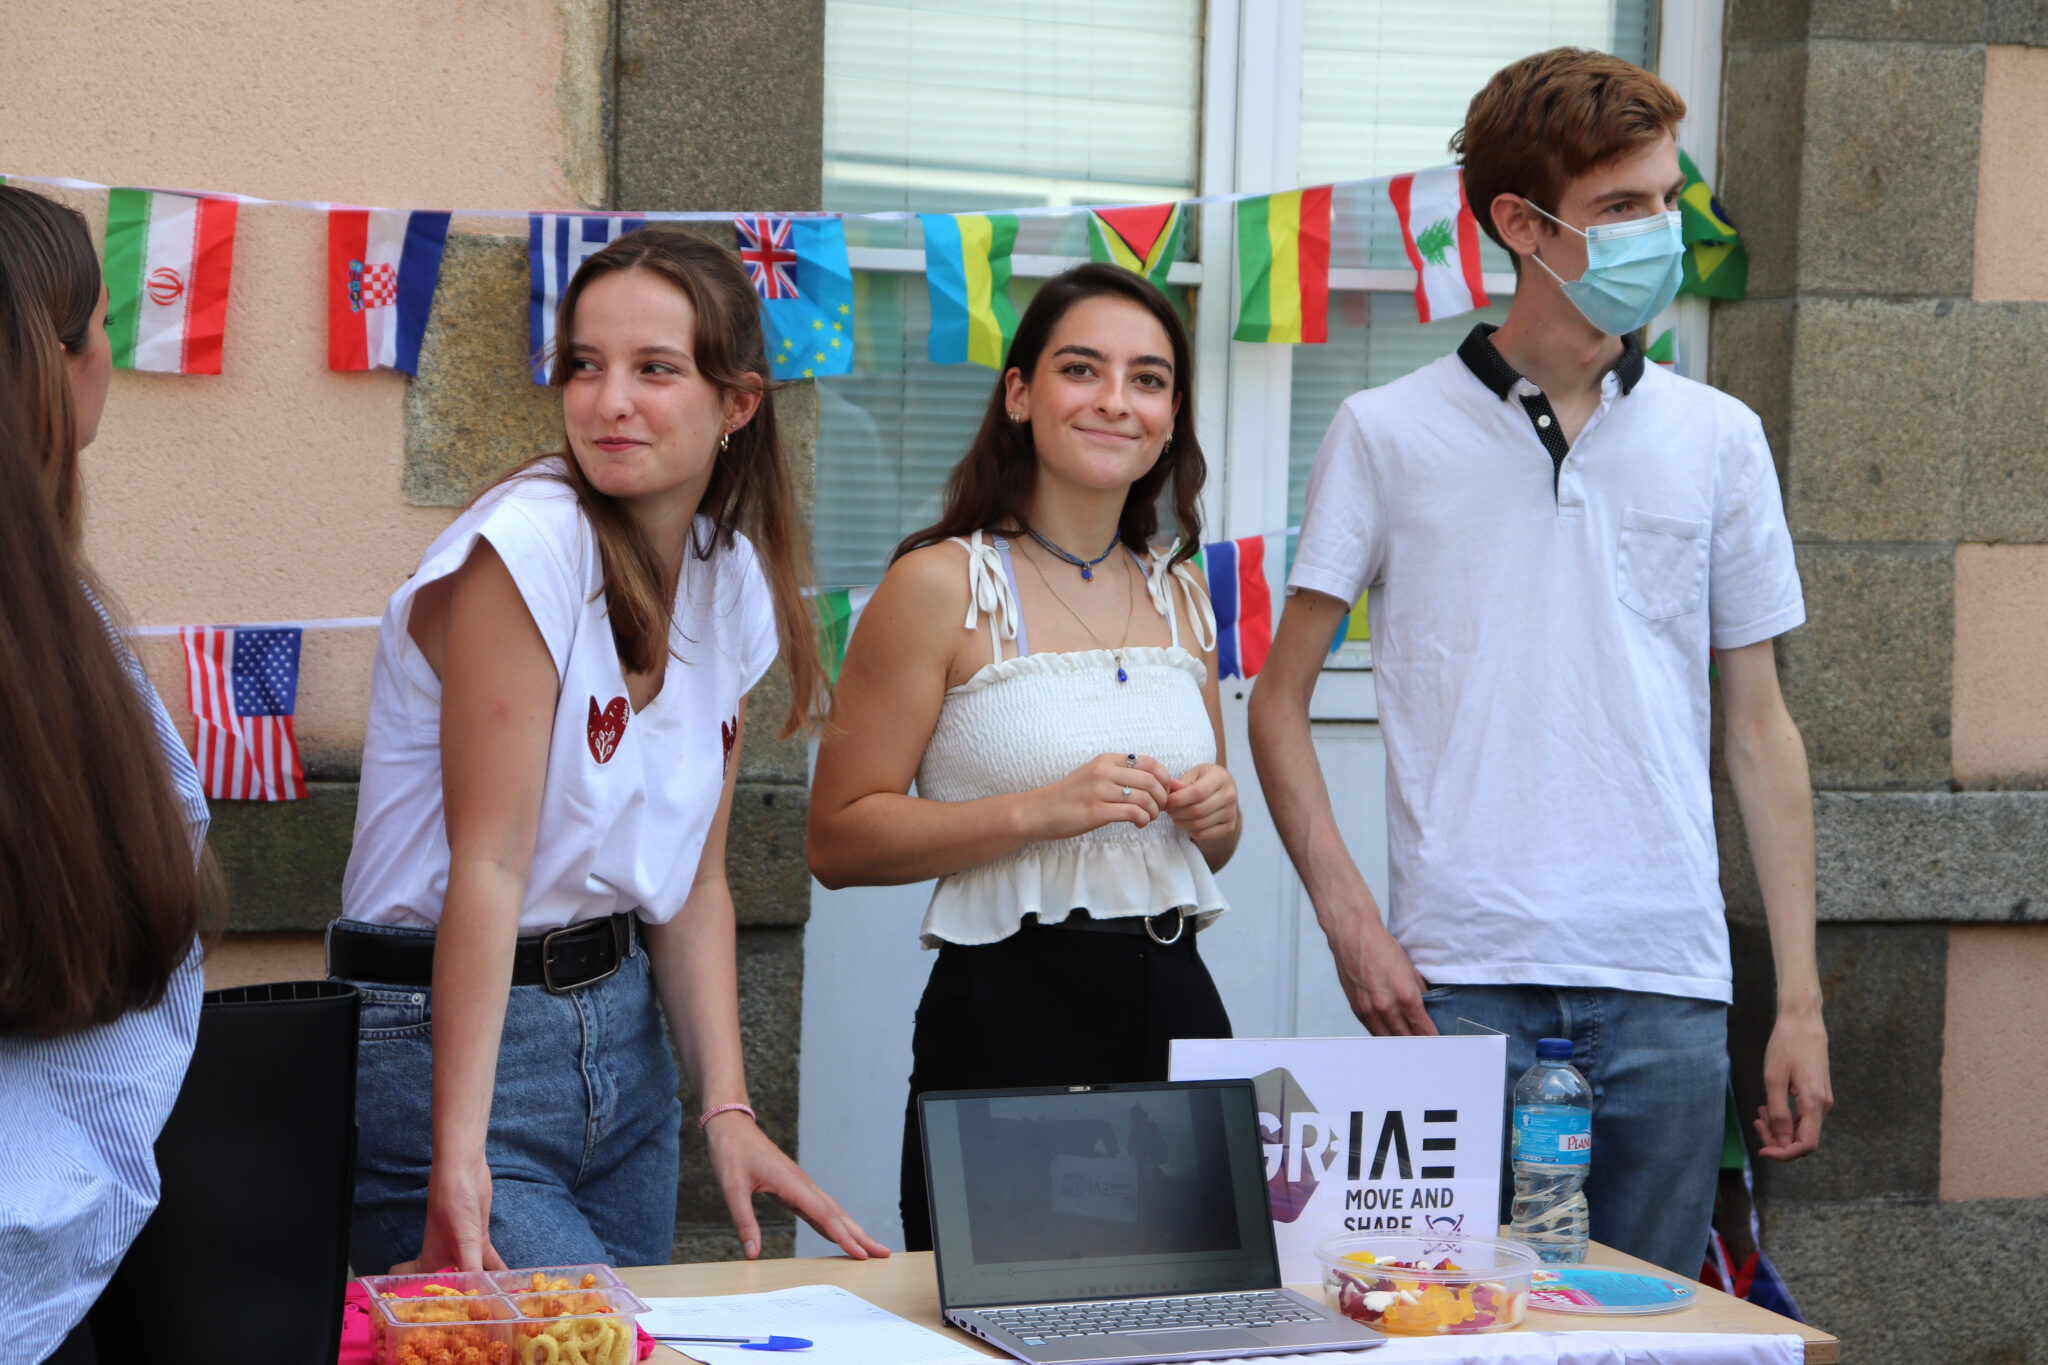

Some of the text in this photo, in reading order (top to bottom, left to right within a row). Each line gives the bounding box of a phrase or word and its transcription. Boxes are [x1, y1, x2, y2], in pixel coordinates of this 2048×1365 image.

[1347, 1109, 1458, 1181] IAE
[1345, 1187, 1454, 1210] MOVE AND
